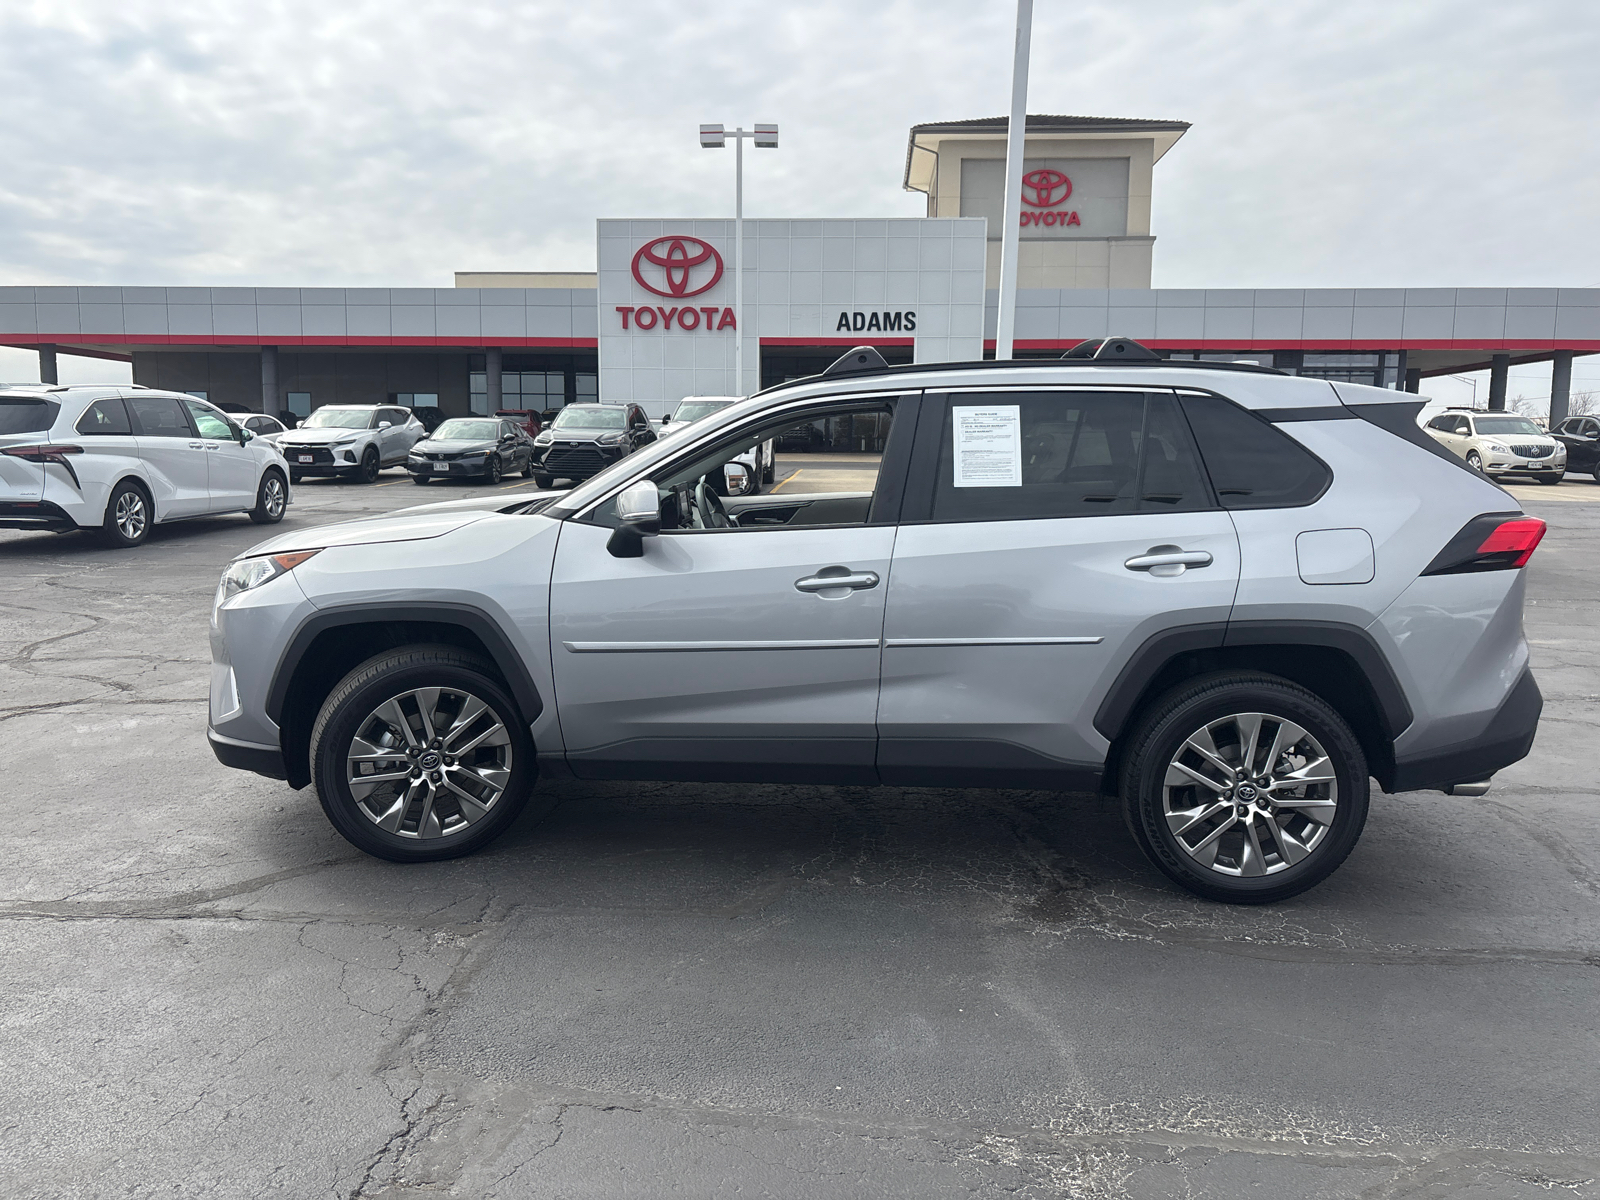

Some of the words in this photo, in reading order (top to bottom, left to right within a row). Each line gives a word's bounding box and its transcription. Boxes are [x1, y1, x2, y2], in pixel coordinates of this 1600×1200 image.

[1020, 211, 1081, 226] OYOTA
[615, 306, 737, 331] TOYOTA
[836, 311, 916, 332] ADAMS
